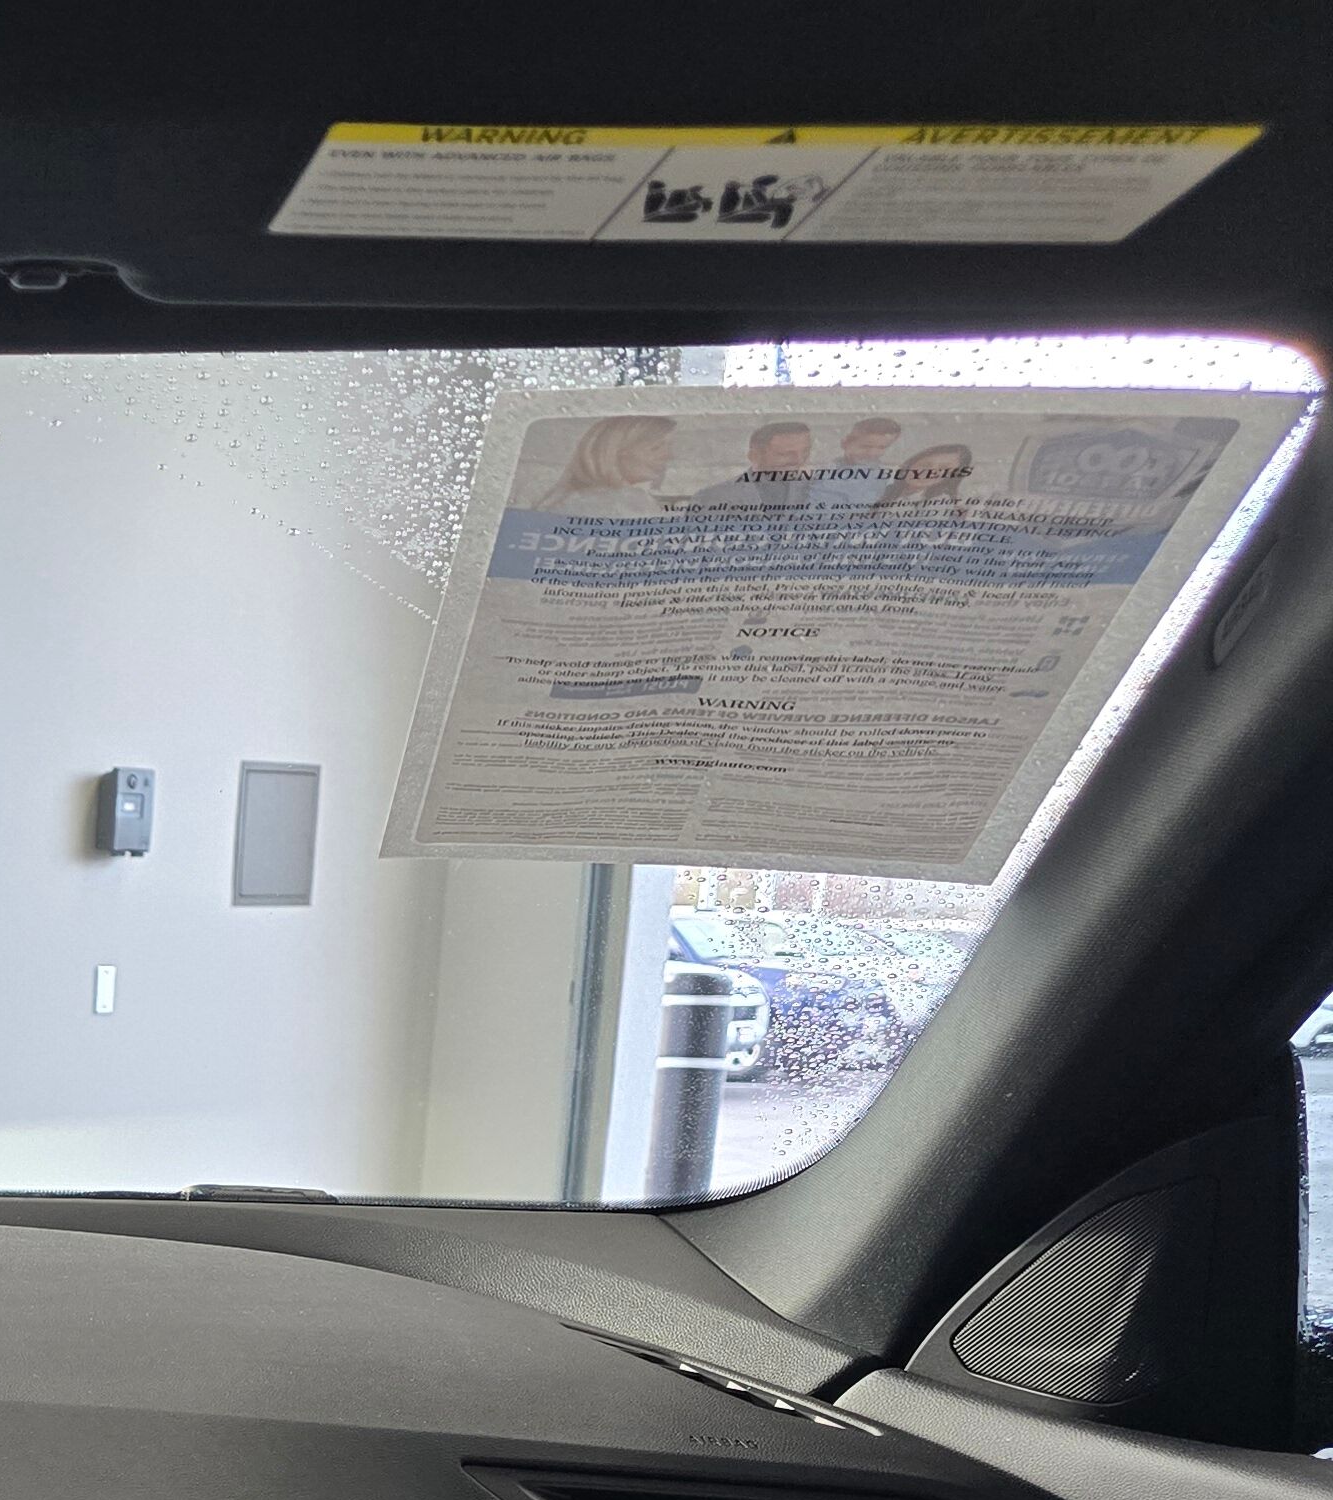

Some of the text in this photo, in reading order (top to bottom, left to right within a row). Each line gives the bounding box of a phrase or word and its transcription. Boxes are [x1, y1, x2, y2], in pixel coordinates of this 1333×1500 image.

[419, 127, 587, 145] WARNING
[898, 127, 1206, 145] AVERTISSEMENT
[734, 467, 974, 483] ATTENTION BUYERS
[663, 503, 705, 514] Verify
[708, 503, 729, 512] all
[730, 502, 810, 514] equipment
[921, 499, 962, 509] prior
[965, 498, 980, 506] to
[568, 508, 1115, 527] THIS VEHICLE EQUIPMENT LIST IS PREPARED BY PARAMO GROUP
[589, 527, 622, 537] FOR
[628, 527, 664, 537] THIS
[668, 525, 737, 535] DEALER
[741, 524, 764, 533] TO
[767, 523, 790, 532] BE
[793, 521, 839, 531] USED
[840, 521, 866, 531] AS
[867, 520, 893, 530] AN
[895, 519, 1042, 536] INFORMATIONAL
[817, 561, 915, 573] independently
[736, 628, 821, 638] NOTICE
[694, 662, 741, 672] remove
[744, 662, 769, 672] this
[698, 697, 796, 711] WARNING
[655, 758, 787, 773] www.pgiauto.com
